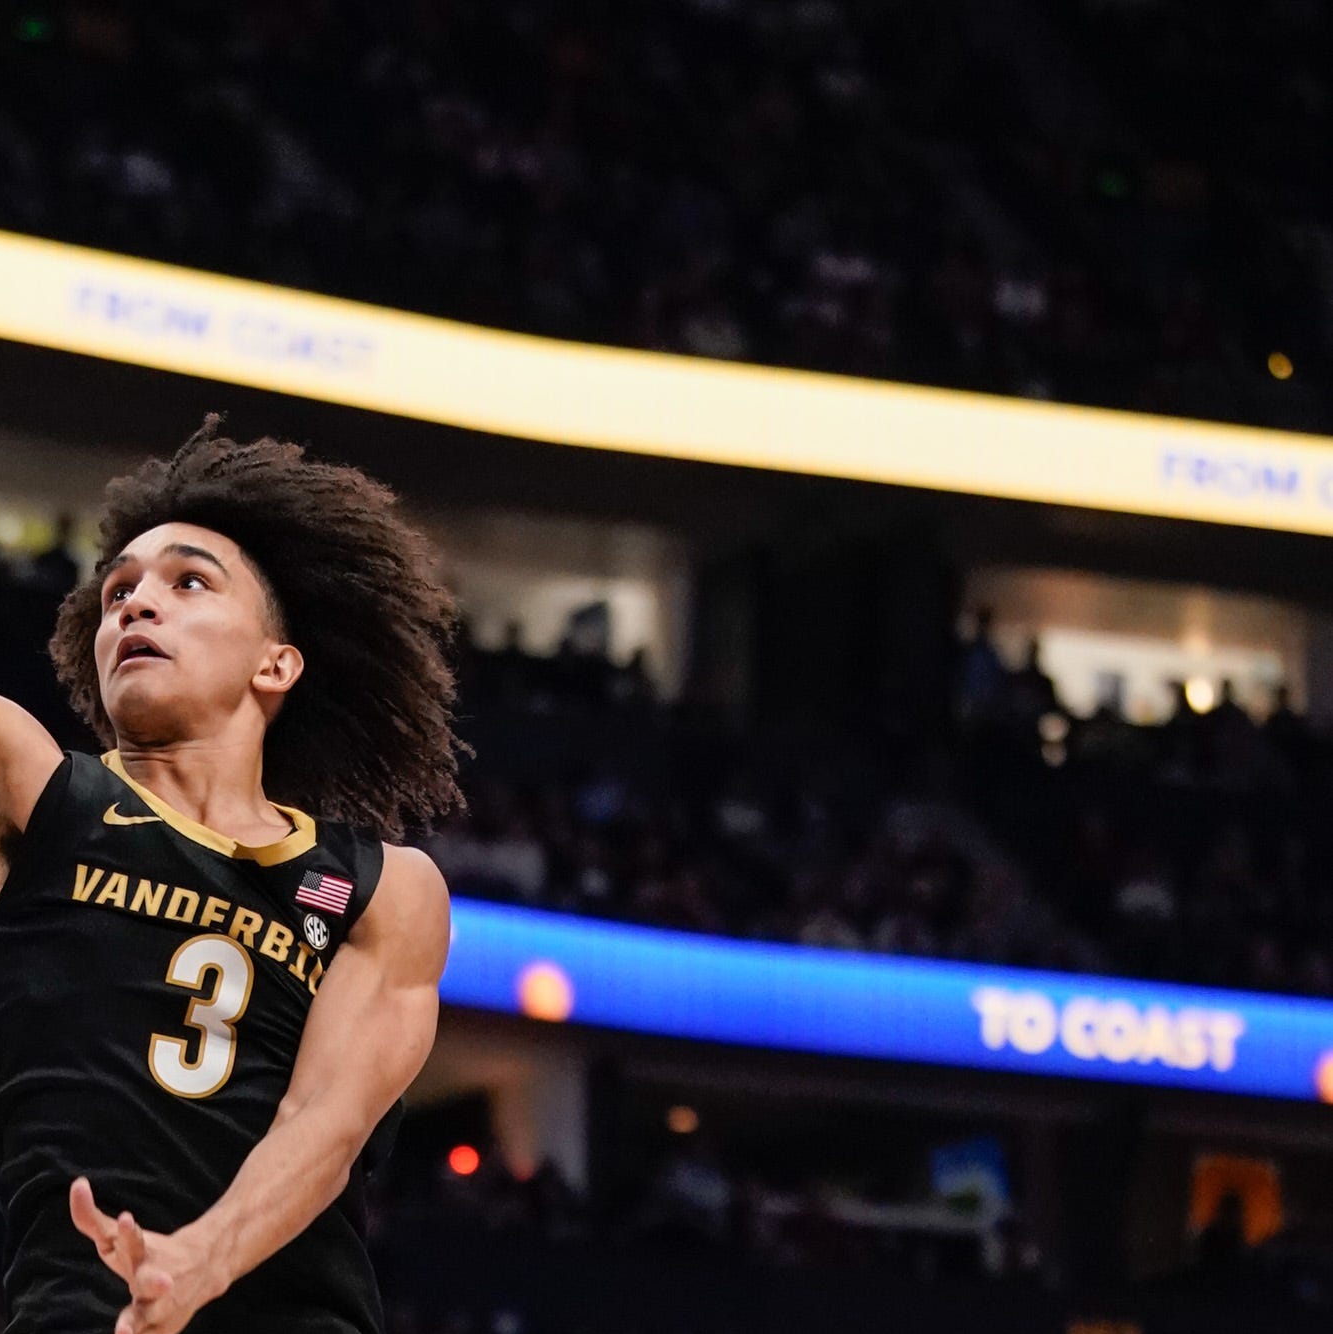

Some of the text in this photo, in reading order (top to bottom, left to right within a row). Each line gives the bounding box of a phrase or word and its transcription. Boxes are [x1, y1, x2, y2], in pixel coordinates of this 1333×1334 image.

[74, 284, 375, 375] FROM COAST
[1160, 450, 1302, 497] FROM
[305, 914, 328, 948] SEC
[148, 932, 255, 1099] 3
[971, 986, 1245, 1073] TO COAST
